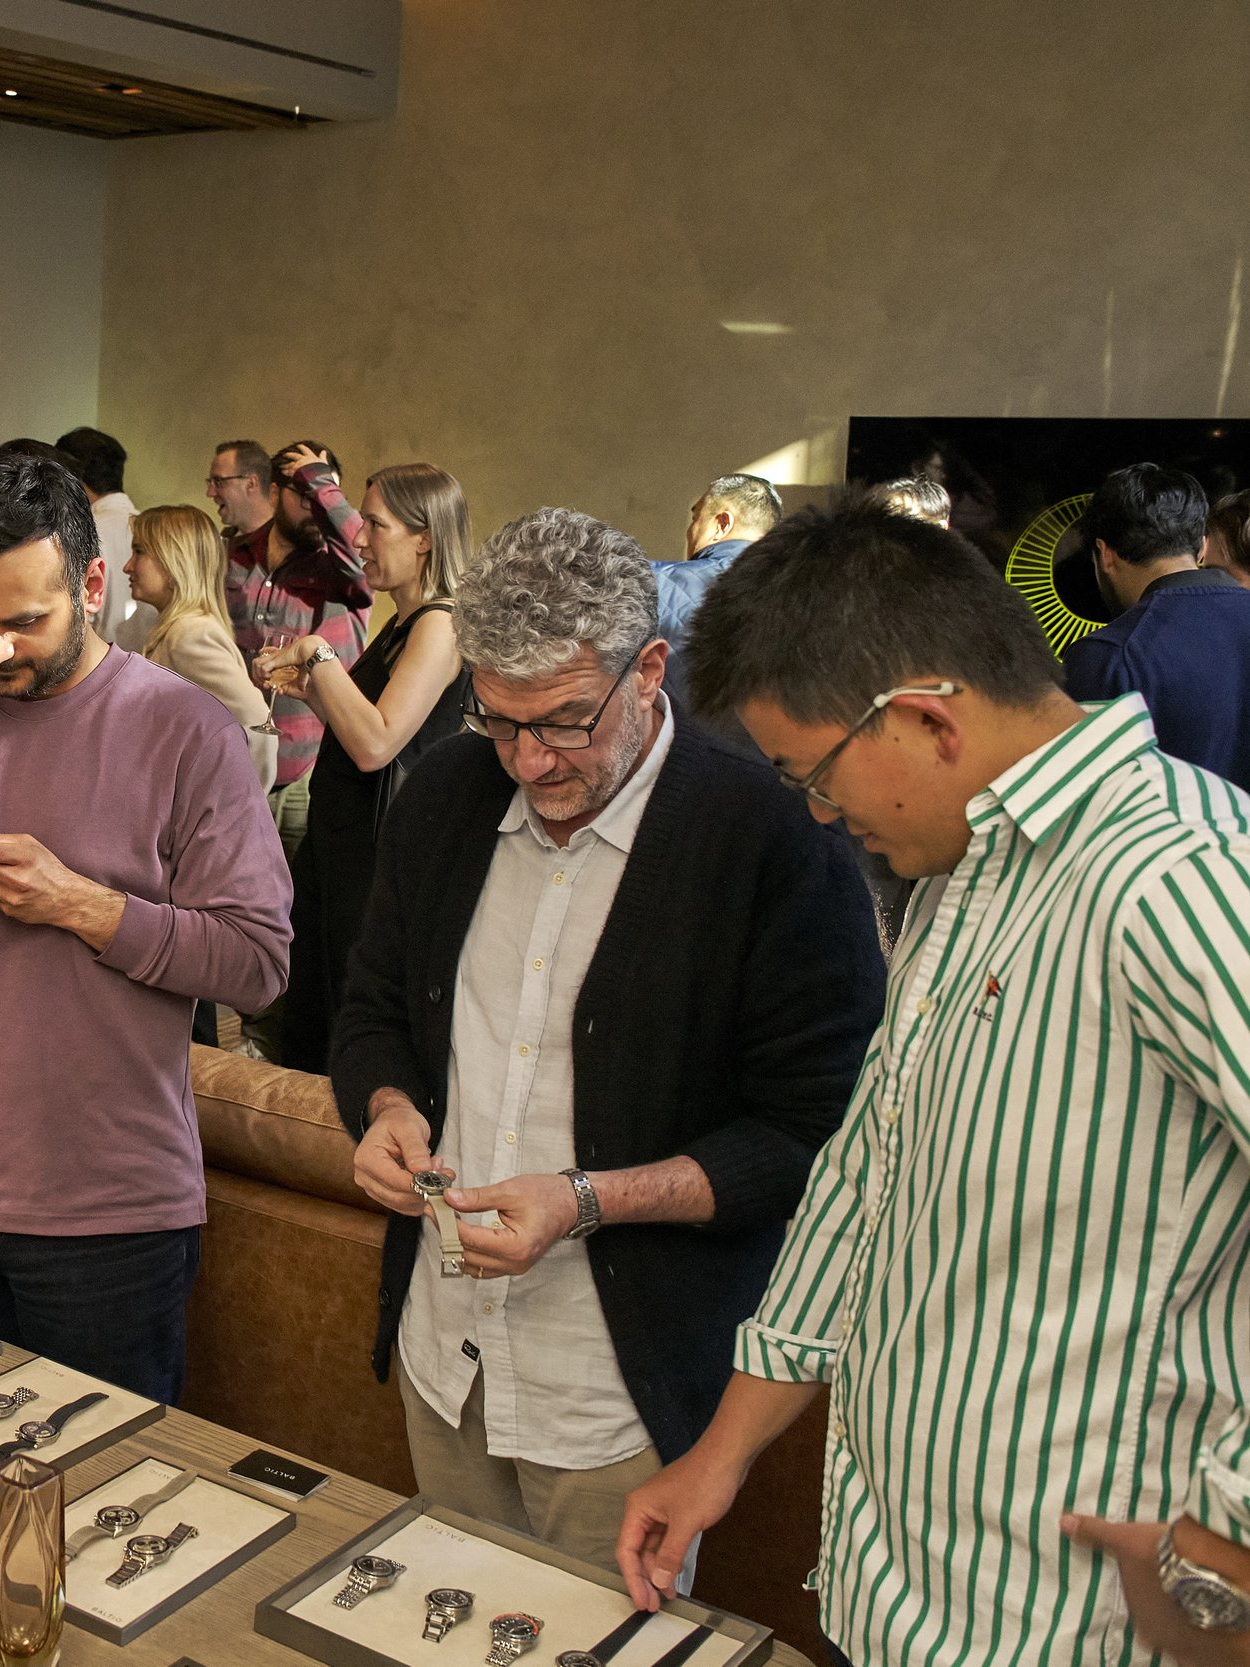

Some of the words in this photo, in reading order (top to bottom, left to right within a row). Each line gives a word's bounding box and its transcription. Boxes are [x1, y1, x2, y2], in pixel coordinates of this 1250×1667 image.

[263, 1466, 296, 1480] BALTIC
[425, 1524, 466, 1543] BALTIC
[91, 1606, 123, 1622] BALTIC
